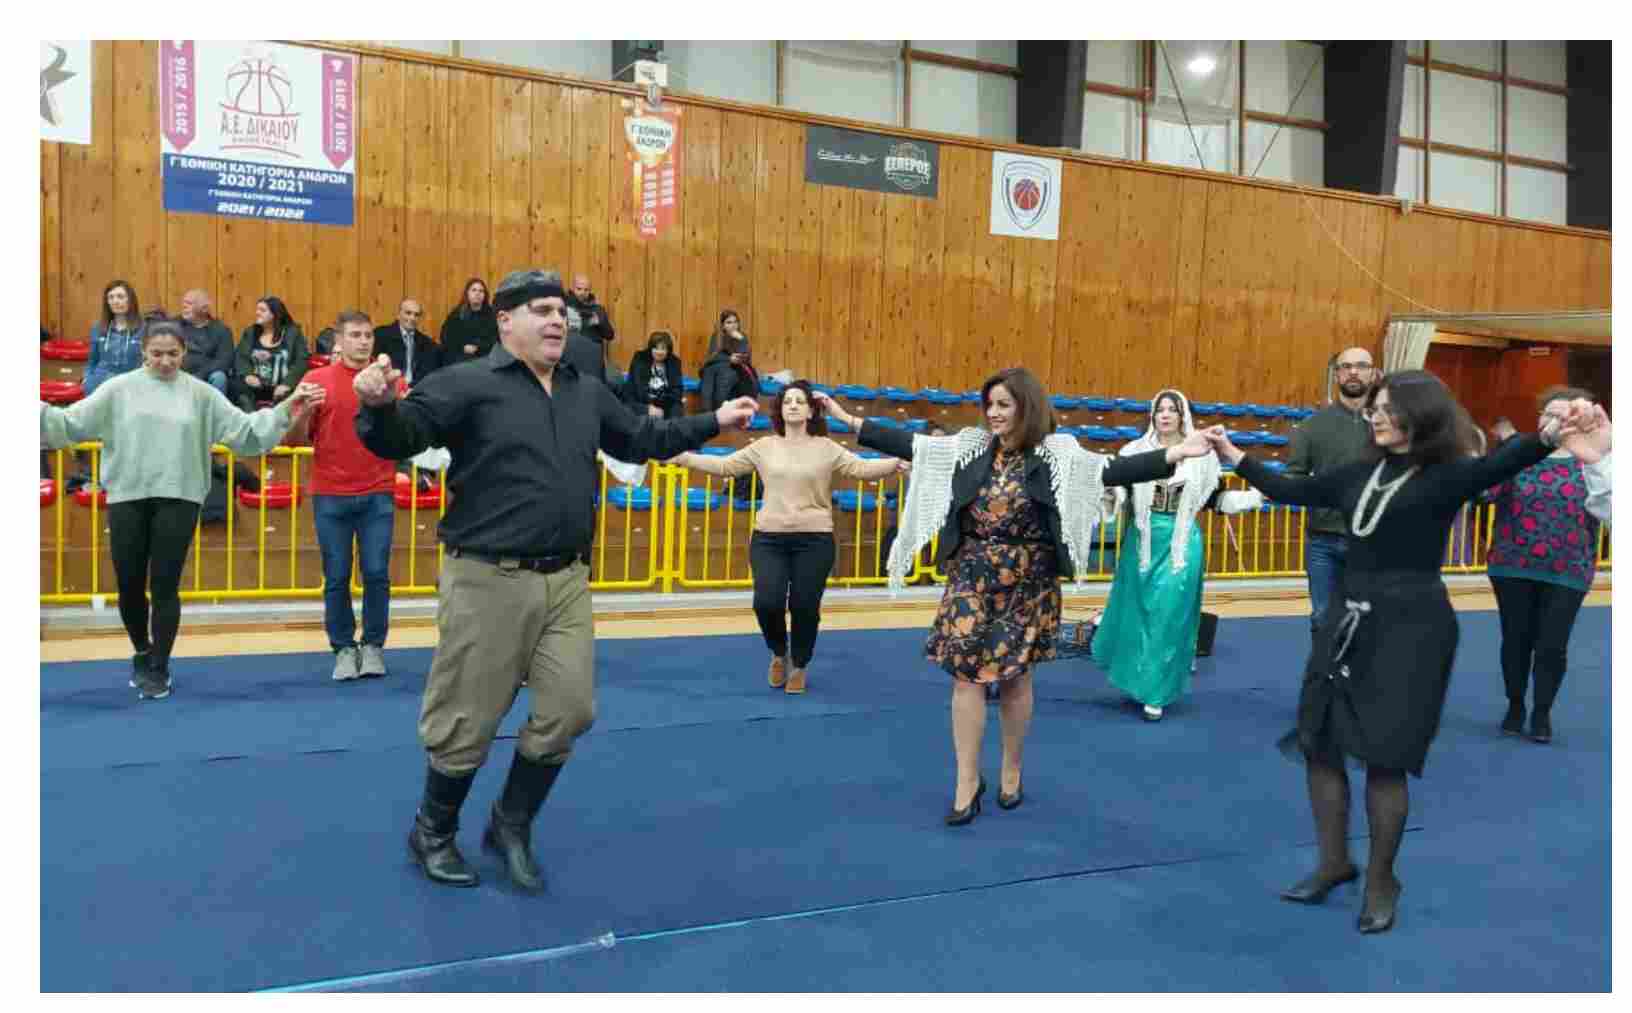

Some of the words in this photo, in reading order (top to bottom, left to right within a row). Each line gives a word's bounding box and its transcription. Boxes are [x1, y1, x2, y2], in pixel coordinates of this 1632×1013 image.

[246, 116, 299, 143] ΔΙΚΑΙΟΥ
[217, 174, 256, 189] 2020
[268, 178, 304, 193] 2021
[229, 162, 295, 179] ΚΑΤΗΓΟΡΙΑ
[297, 169, 347, 185] ΑΝΔΡΩΝ
[217, 202, 254, 214] 2021
